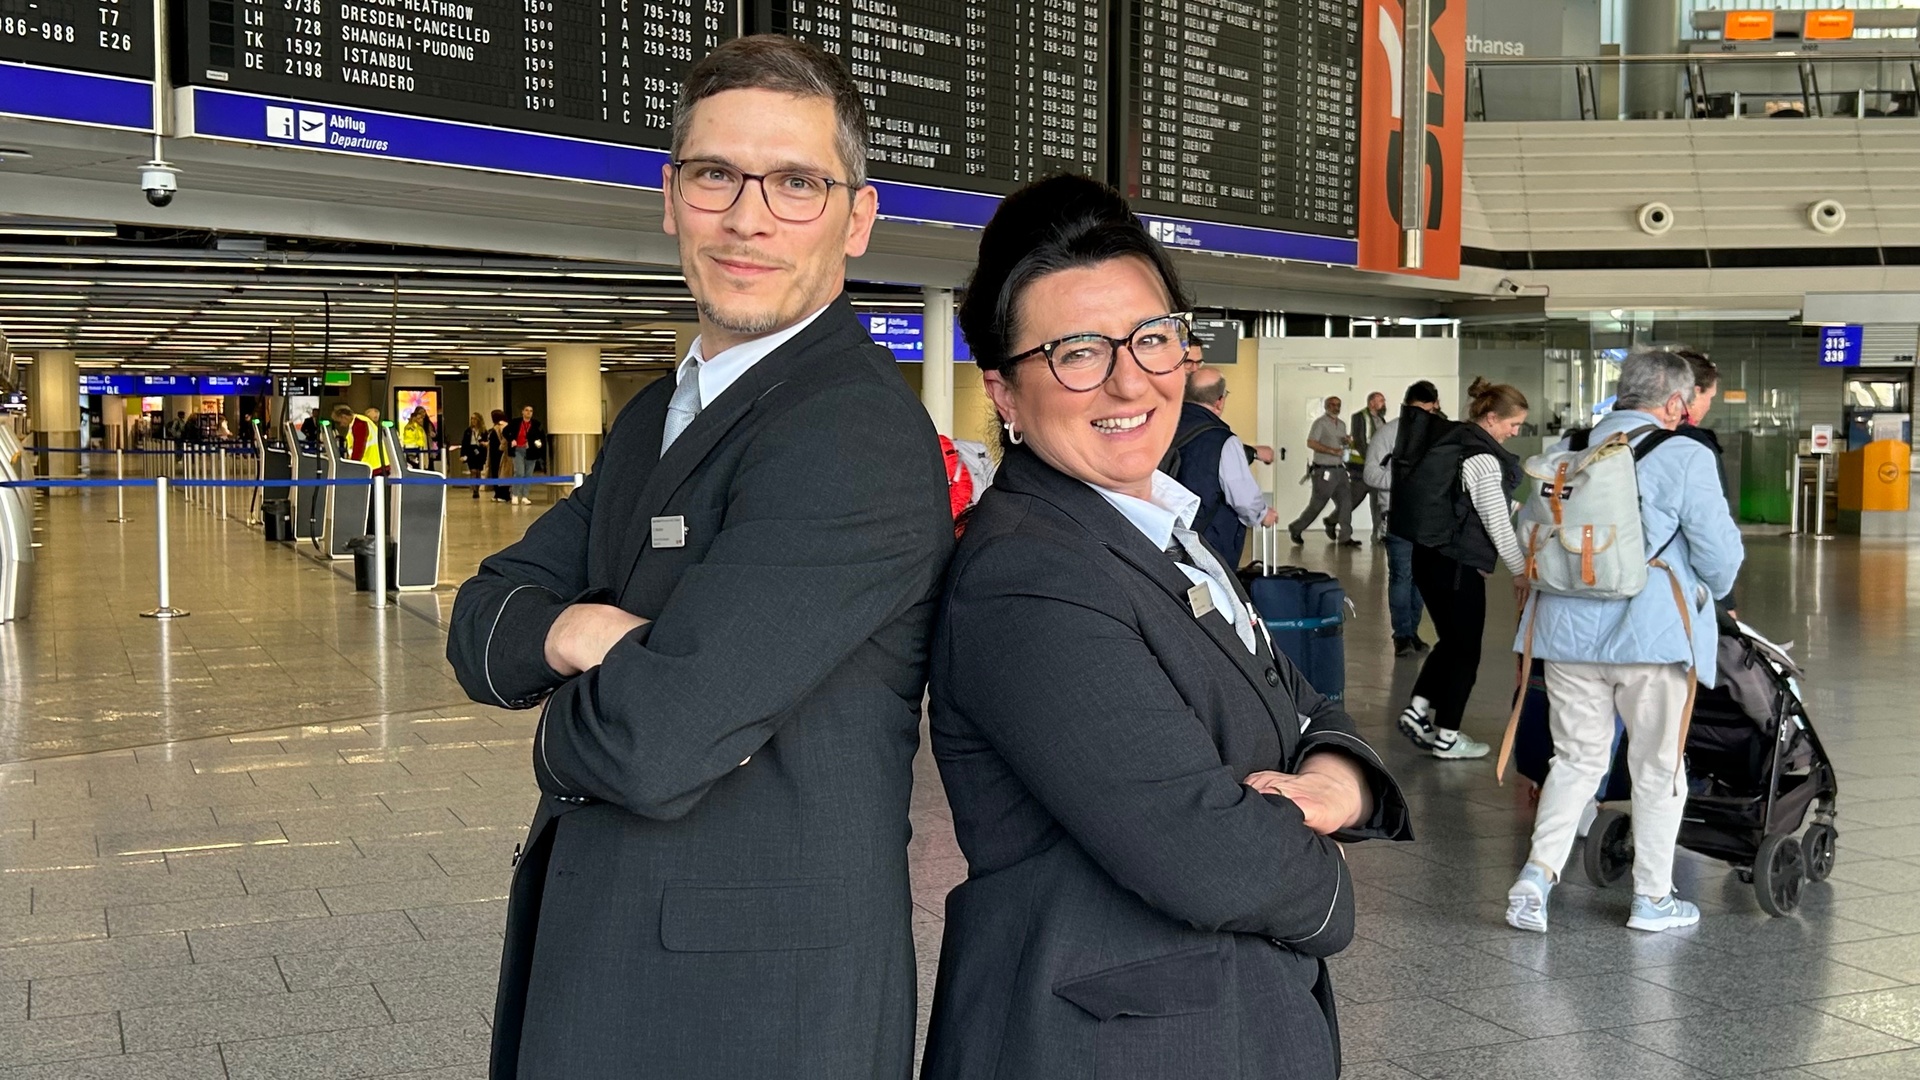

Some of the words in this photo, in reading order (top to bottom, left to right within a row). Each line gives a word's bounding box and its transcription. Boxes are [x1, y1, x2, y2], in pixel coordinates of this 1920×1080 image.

[99, 8, 119, 26] T7
[621, 0, 629, 12] C
[643, 4, 691, 25] 795-798
[705, 16, 718, 30] C6
[704, 0, 725, 14] A32
[1029, 7, 1035, 18] A
[0, 17, 74, 43] 86-988
[100, 31, 131, 51] E26
[341, 4, 490, 44] DRESDEN-CANCELLED
[525, 37, 553, 52] 1509
[601, 51, 606, 64] 1
[622, 55, 629, 68] A
[524, 0, 553, 13] 1500
[601, 14, 606, 27] 1
[621, 18, 629, 31] A
[643, 22, 691, 43] 259-335
[705, 34, 718, 47] A1
[1029, 22, 1035, 33] C
[525, 18, 553, 32] 1500
[601, 33, 606, 45] 1
[622, 36, 629, 49] A
[643, 40, 692, 62] 259-335
[793, 0, 805, 14] LH
[817, 5, 840, 21] 3464
[1029, 52, 1035, 63] A
[1084, 64, 1093, 76] T4
[793, 17, 811, 32] EJU
[817, 22, 840, 38] 2993
[1015, 64, 1020, 76] 2
[1029, 37, 1035, 48] A
[1465, 34, 1524, 56] thansa
[245, 9, 264, 27] LH
[295, 18, 322, 36] 728
[341, 25, 474, 61] SHANGHAI-PUDONG
[525, 56, 553, 71] 1505
[602, 70, 607, 83] 1
[622, 73, 630, 87] A
[644, 77, 683, 95] 259-3
[245, 30, 264, 48] TK
[286, 37, 322, 58] 1592
[344, 47, 414, 71] ISTANBUL
[525, 76, 553, 90] 1505
[602, 89, 607, 101] 1
[623, 92, 630, 105] C
[823, 41, 840, 55] 320
[852, 46, 881, 63] OLBIA
[1029, 82, 1034, 93] A
[245, 51, 264, 70] DE
[285, 59, 322, 78] 2198
[342, 66, 415, 92] VARADERO
[525, 95, 555, 110] 1510
[603, 107, 608, 120] 1
[623, 110, 630, 124] C
[852, 63, 951, 93] BERLIN-BRANDENBURG
[1029, 97, 1034, 108] A
[329, 114, 366, 135] Abflug
[1029, 112, 1034, 123] A
[329, 132, 389, 152] Departures
[919, 124, 940, 138] ALIA
[1014, 140, 1019, 151] 2
[1029, 142, 1033, 153] E
[1029, 127, 1034, 138] A
[869, 132, 951, 155] LSRUHE-MANNHEIM
[1029, 157, 1034, 168] A
[1014, 170, 1019, 181] 2
[1029, 172, 1033, 182] E
